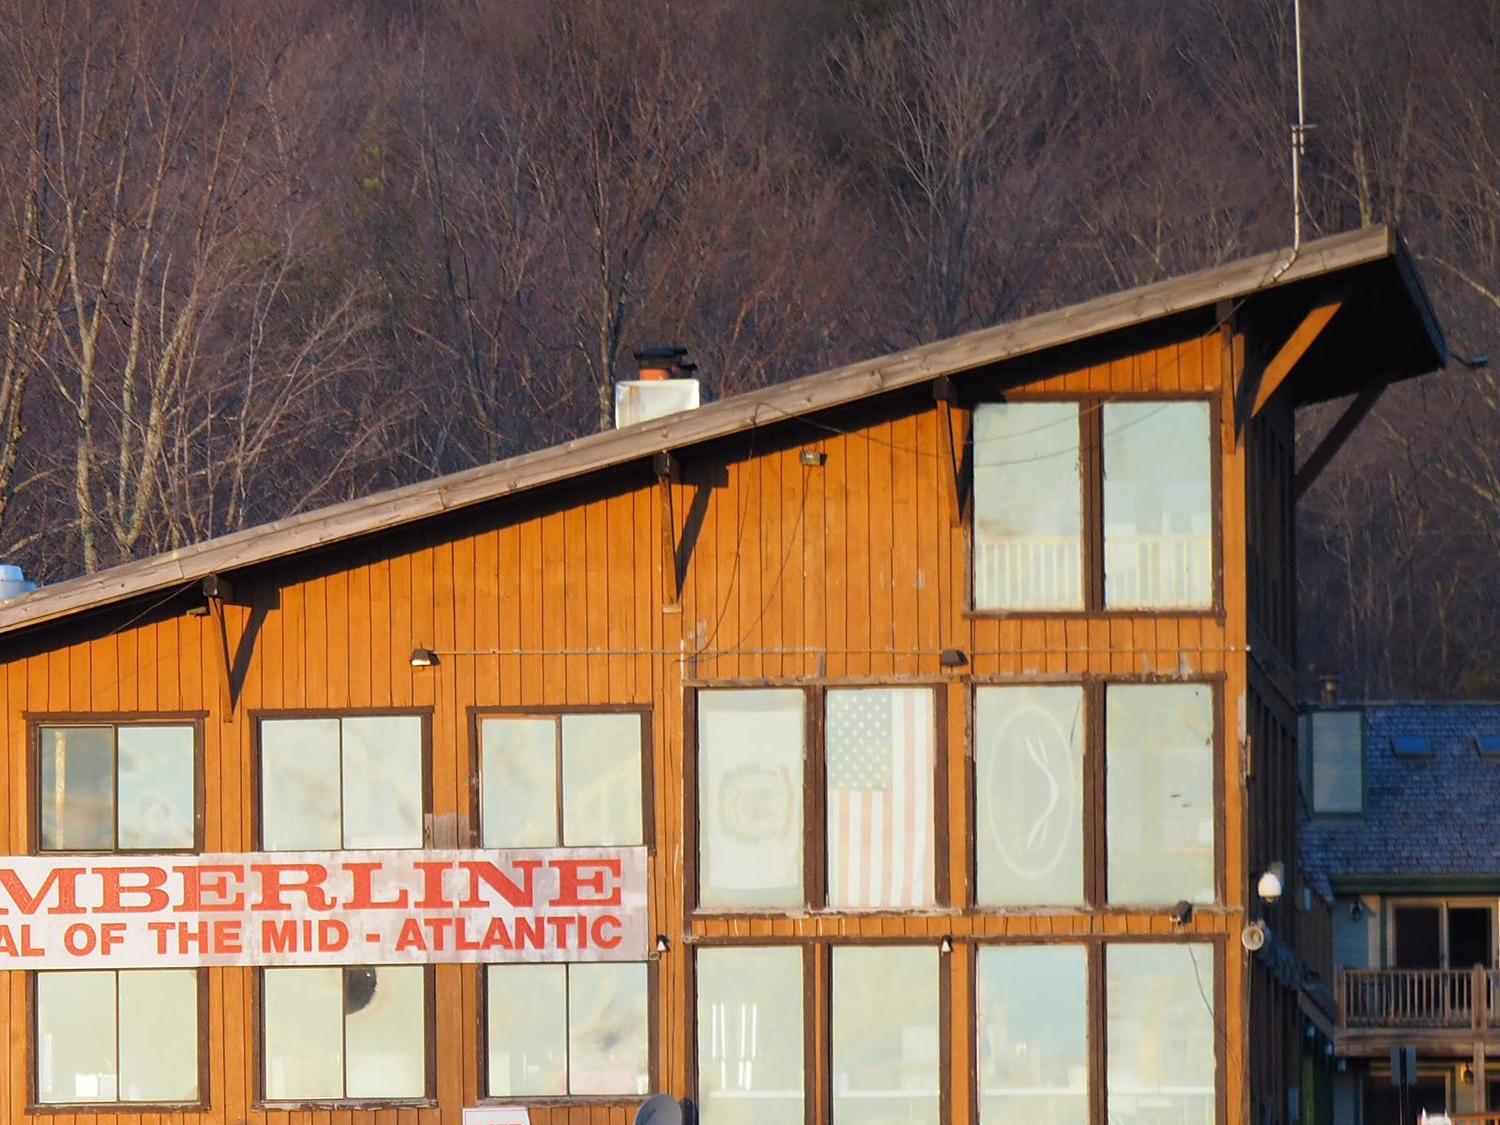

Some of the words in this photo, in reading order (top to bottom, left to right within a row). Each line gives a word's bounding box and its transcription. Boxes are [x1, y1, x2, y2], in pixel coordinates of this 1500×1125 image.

[65, 922, 124, 957] OF
[148, 920, 242, 955] THE
[262, 918, 349, 953] MID
[394, 914, 623, 951] ATLANTIC
